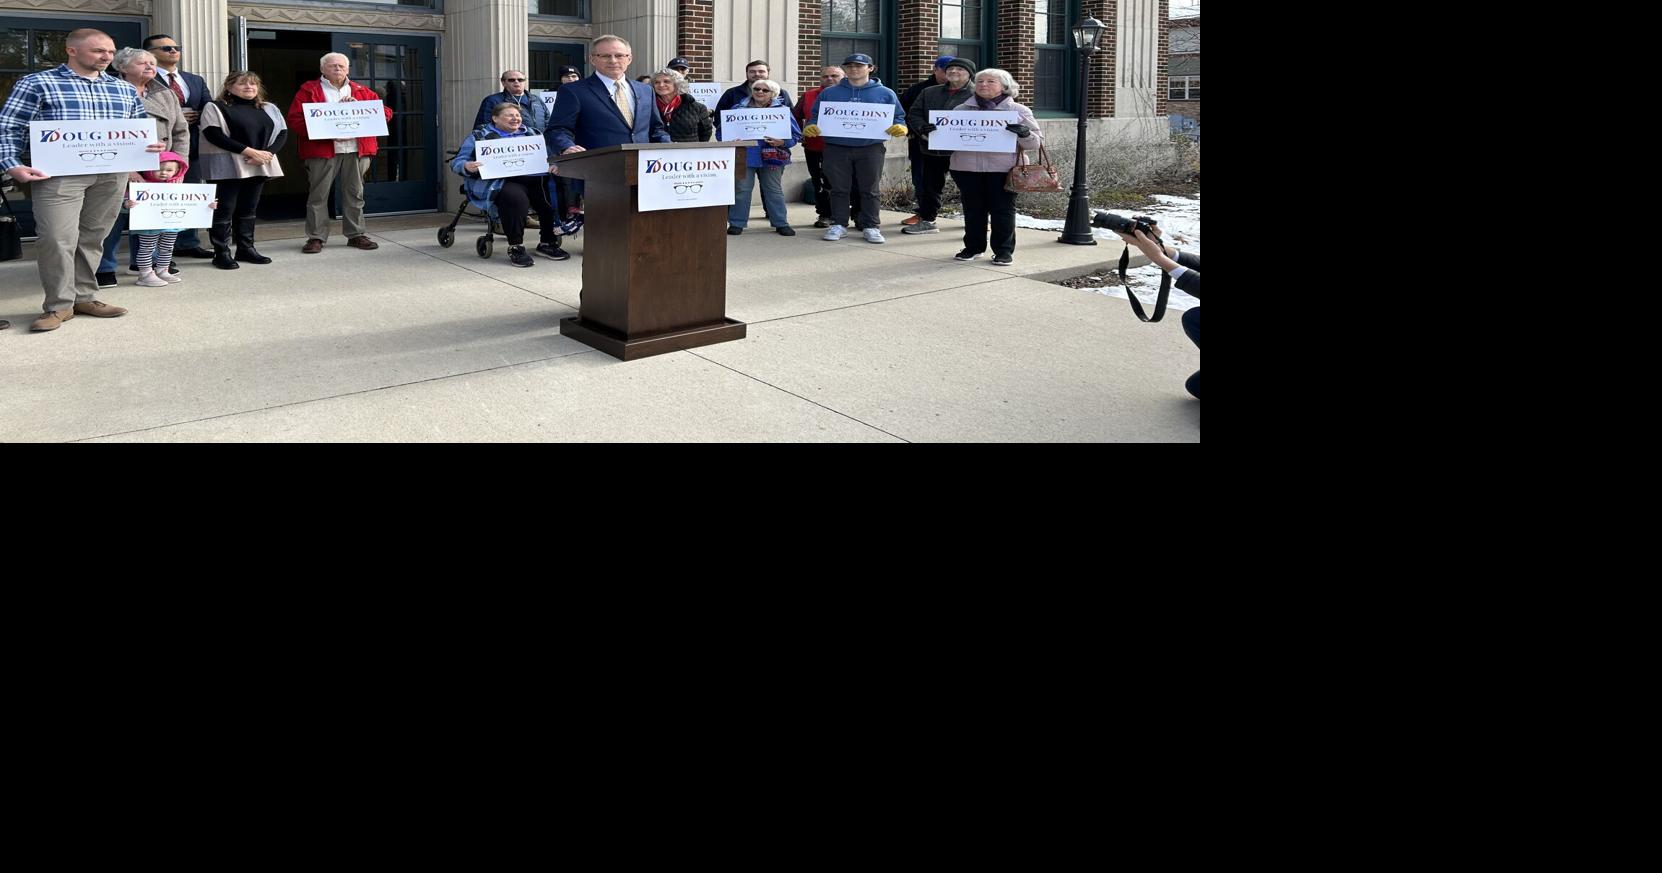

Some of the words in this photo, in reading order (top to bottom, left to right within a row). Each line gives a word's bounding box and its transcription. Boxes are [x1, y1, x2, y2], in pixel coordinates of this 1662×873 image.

[310, 109, 348, 117] DOUG
[824, 107, 858, 116] DOUG
[936, 117, 977, 126] DOUG
[40, 128, 101, 142] DOUG
[108, 130, 149, 140] DINY
[481, 145, 514, 156] DOUG
[646, 158, 692, 173] DOUG
[697, 160, 729, 170] DINY
[136, 190, 177, 200] DOUG
